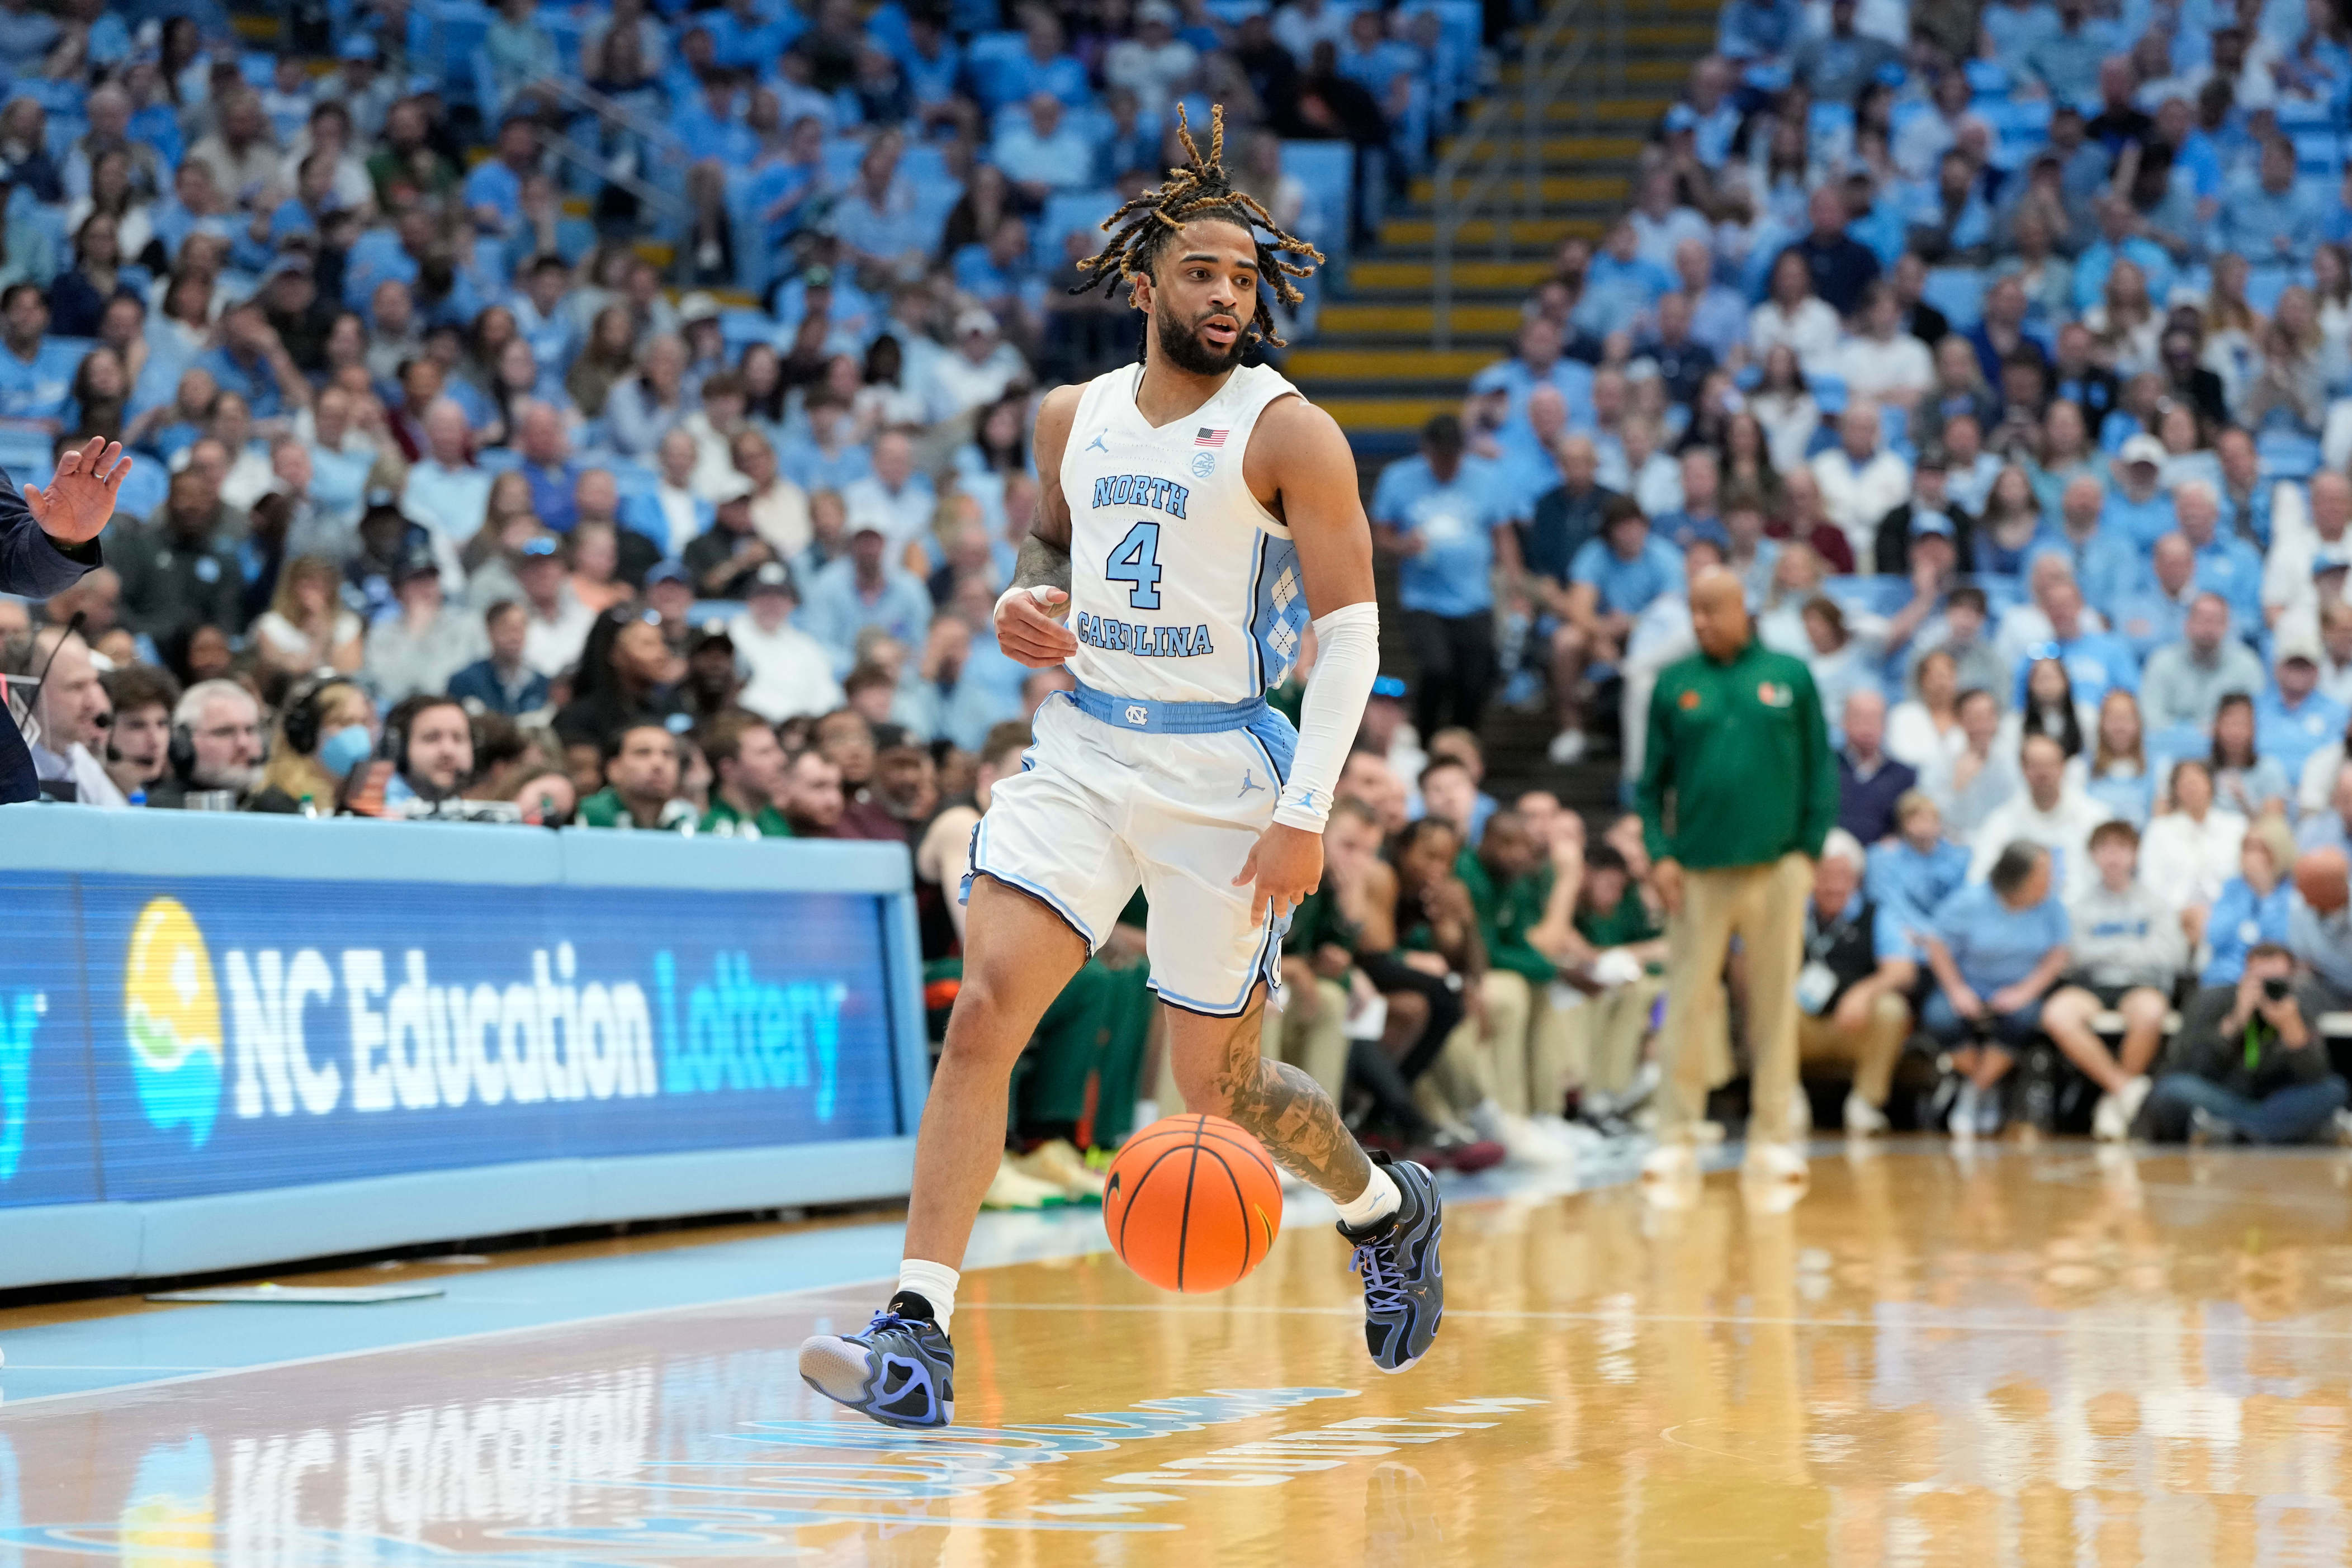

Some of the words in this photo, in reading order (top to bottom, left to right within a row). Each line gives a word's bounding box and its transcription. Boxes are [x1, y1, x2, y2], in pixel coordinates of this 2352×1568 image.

[1092, 474, 1189, 520] NORTH
[1105, 521, 1162, 610] 4
[1077, 611, 1214, 657] CAROLINA
[225, 949, 342, 1119] NC
[342, 940, 659, 1112] Education
[654, 949, 845, 1123] Lottery
[1101, 1416, 1503, 1487] COURT
